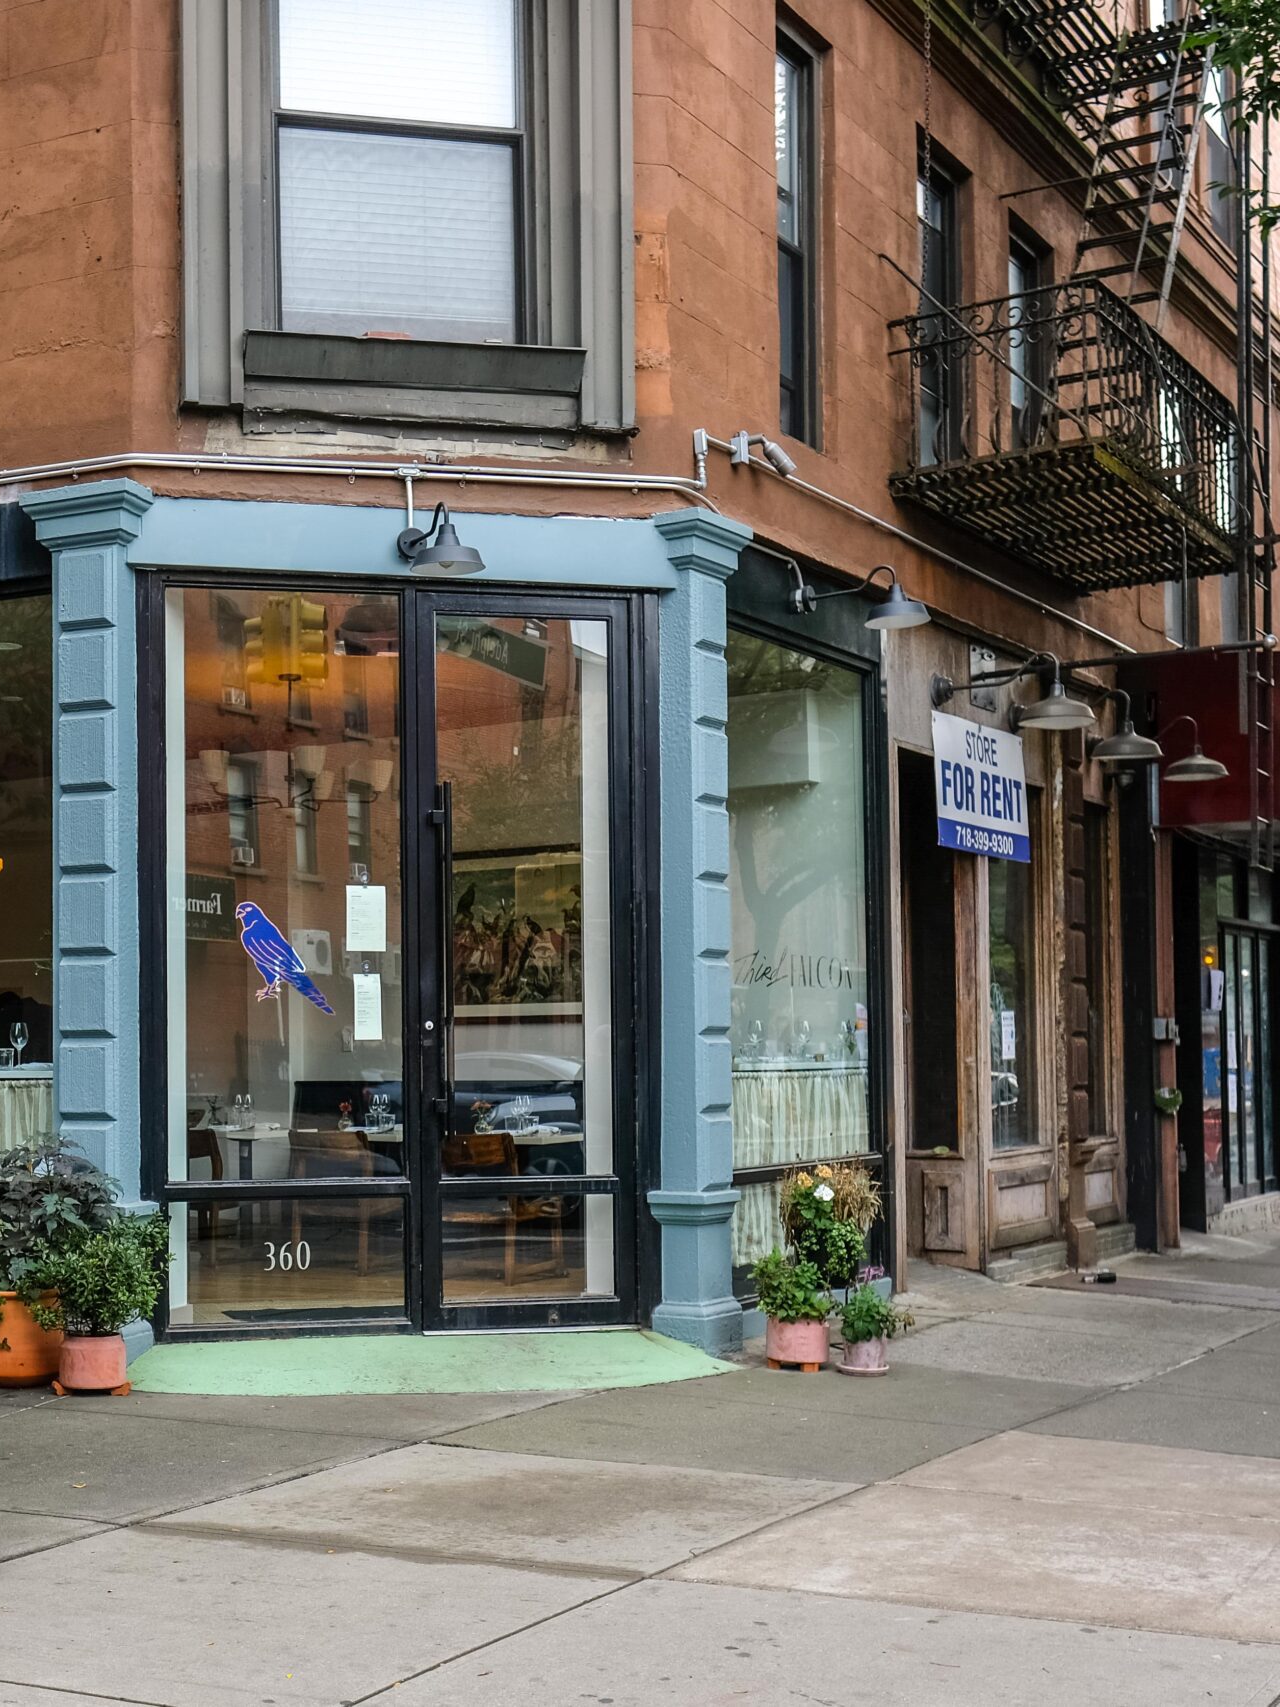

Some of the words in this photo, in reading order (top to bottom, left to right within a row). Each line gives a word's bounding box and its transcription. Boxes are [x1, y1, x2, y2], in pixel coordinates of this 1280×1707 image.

[965, 730, 999, 768] STORE
[940, 759, 976, 814] FOR
[980, 771, 1022, 824] RENT
[955, 825, 1014, 856] 718-399-9300
[263, 1241, 311, 1271] 360
